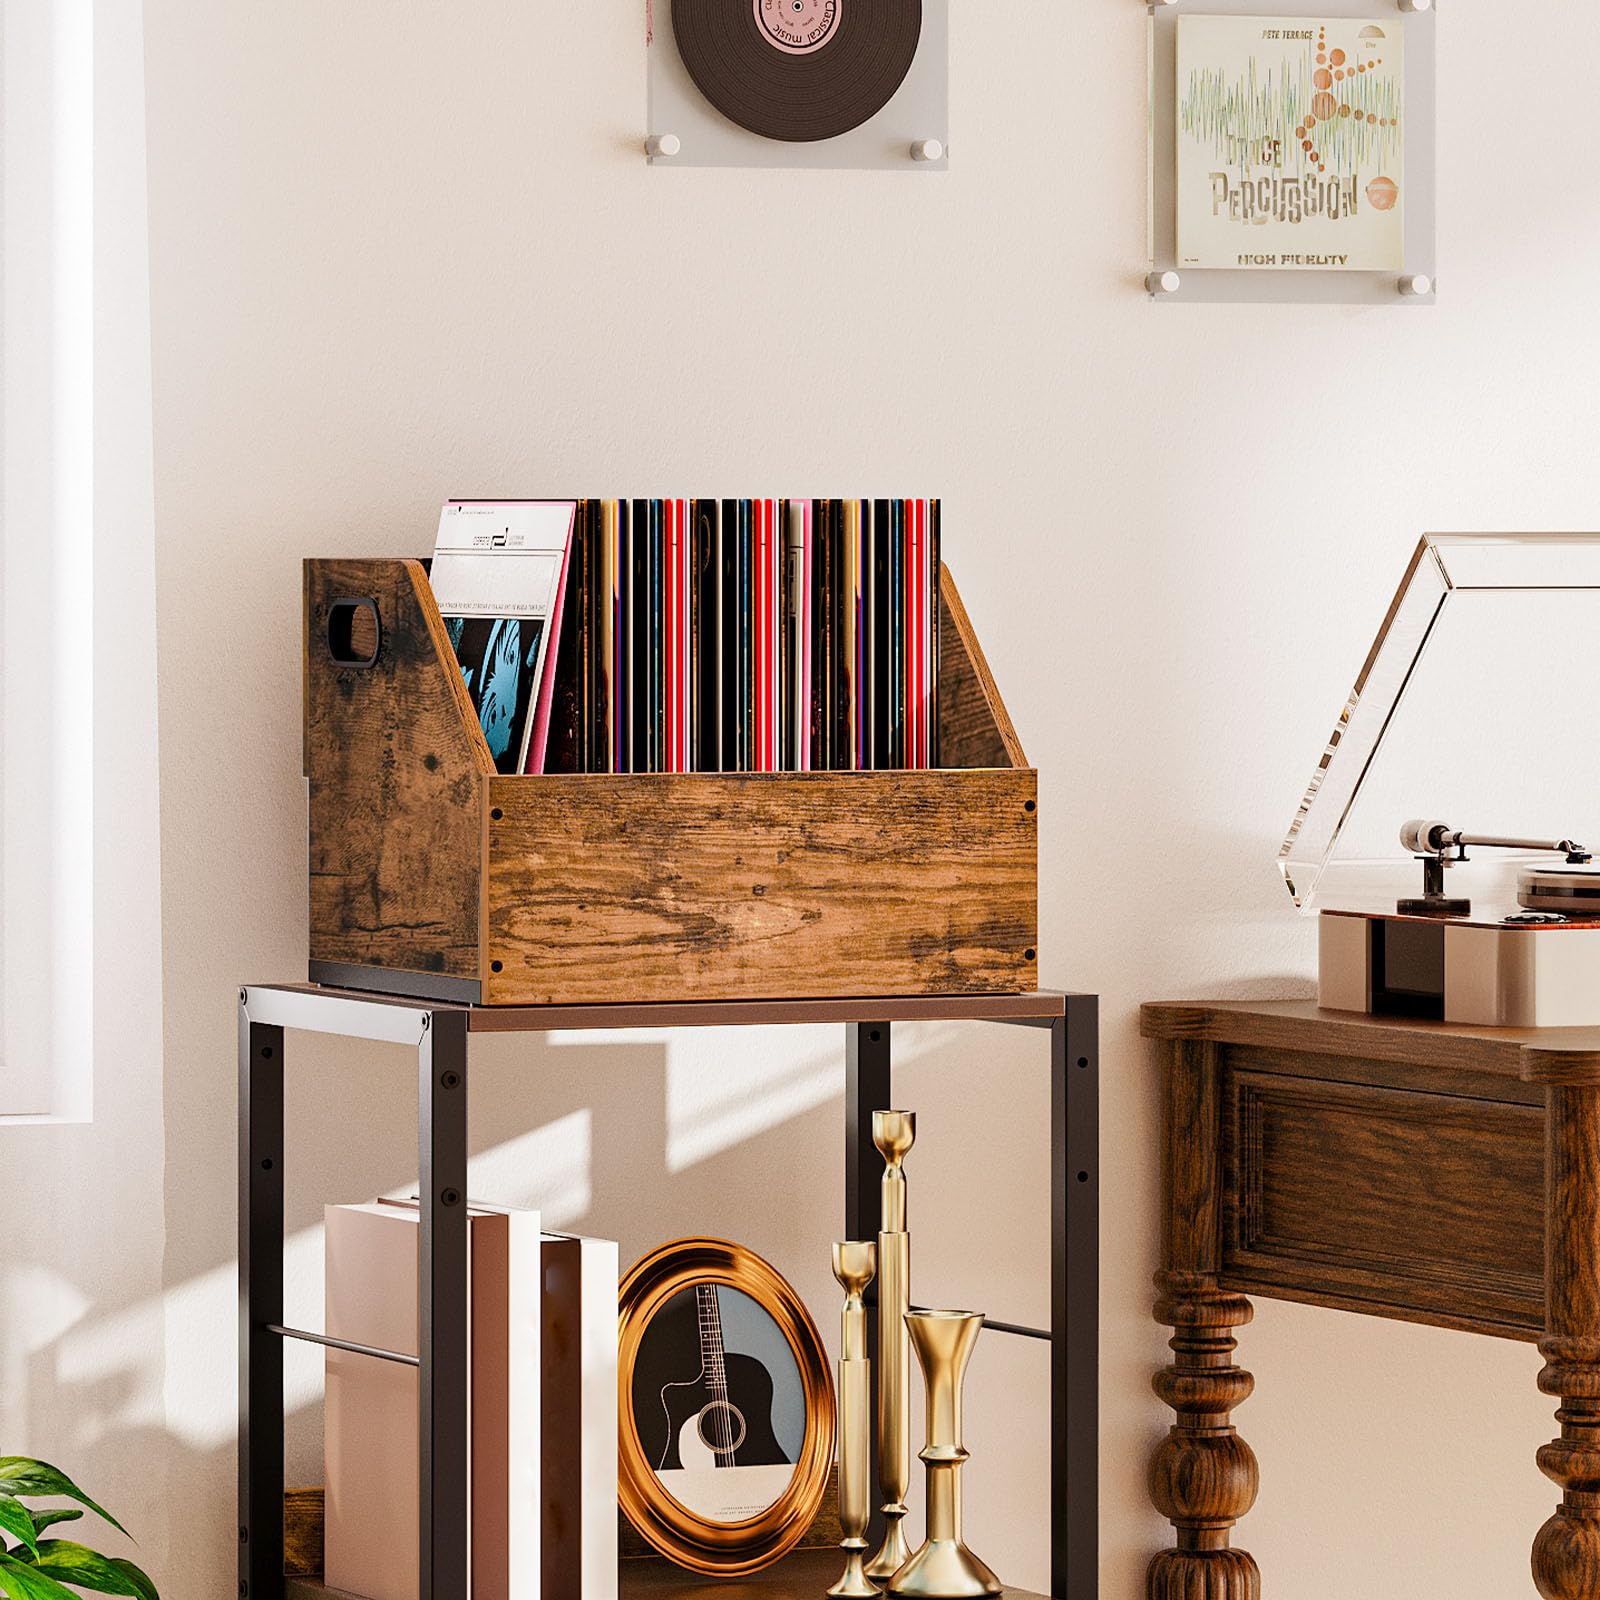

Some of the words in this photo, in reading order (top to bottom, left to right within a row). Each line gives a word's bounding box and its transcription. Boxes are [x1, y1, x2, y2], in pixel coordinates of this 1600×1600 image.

[807, 1, 835, 44] Classical
[772, 24, 802, 43] music
[1262, 30, 1280, 40] PETE
[1238, 254, 1276, 265] HIGH
[1281, 254, 1348, 265] FIDELITY
